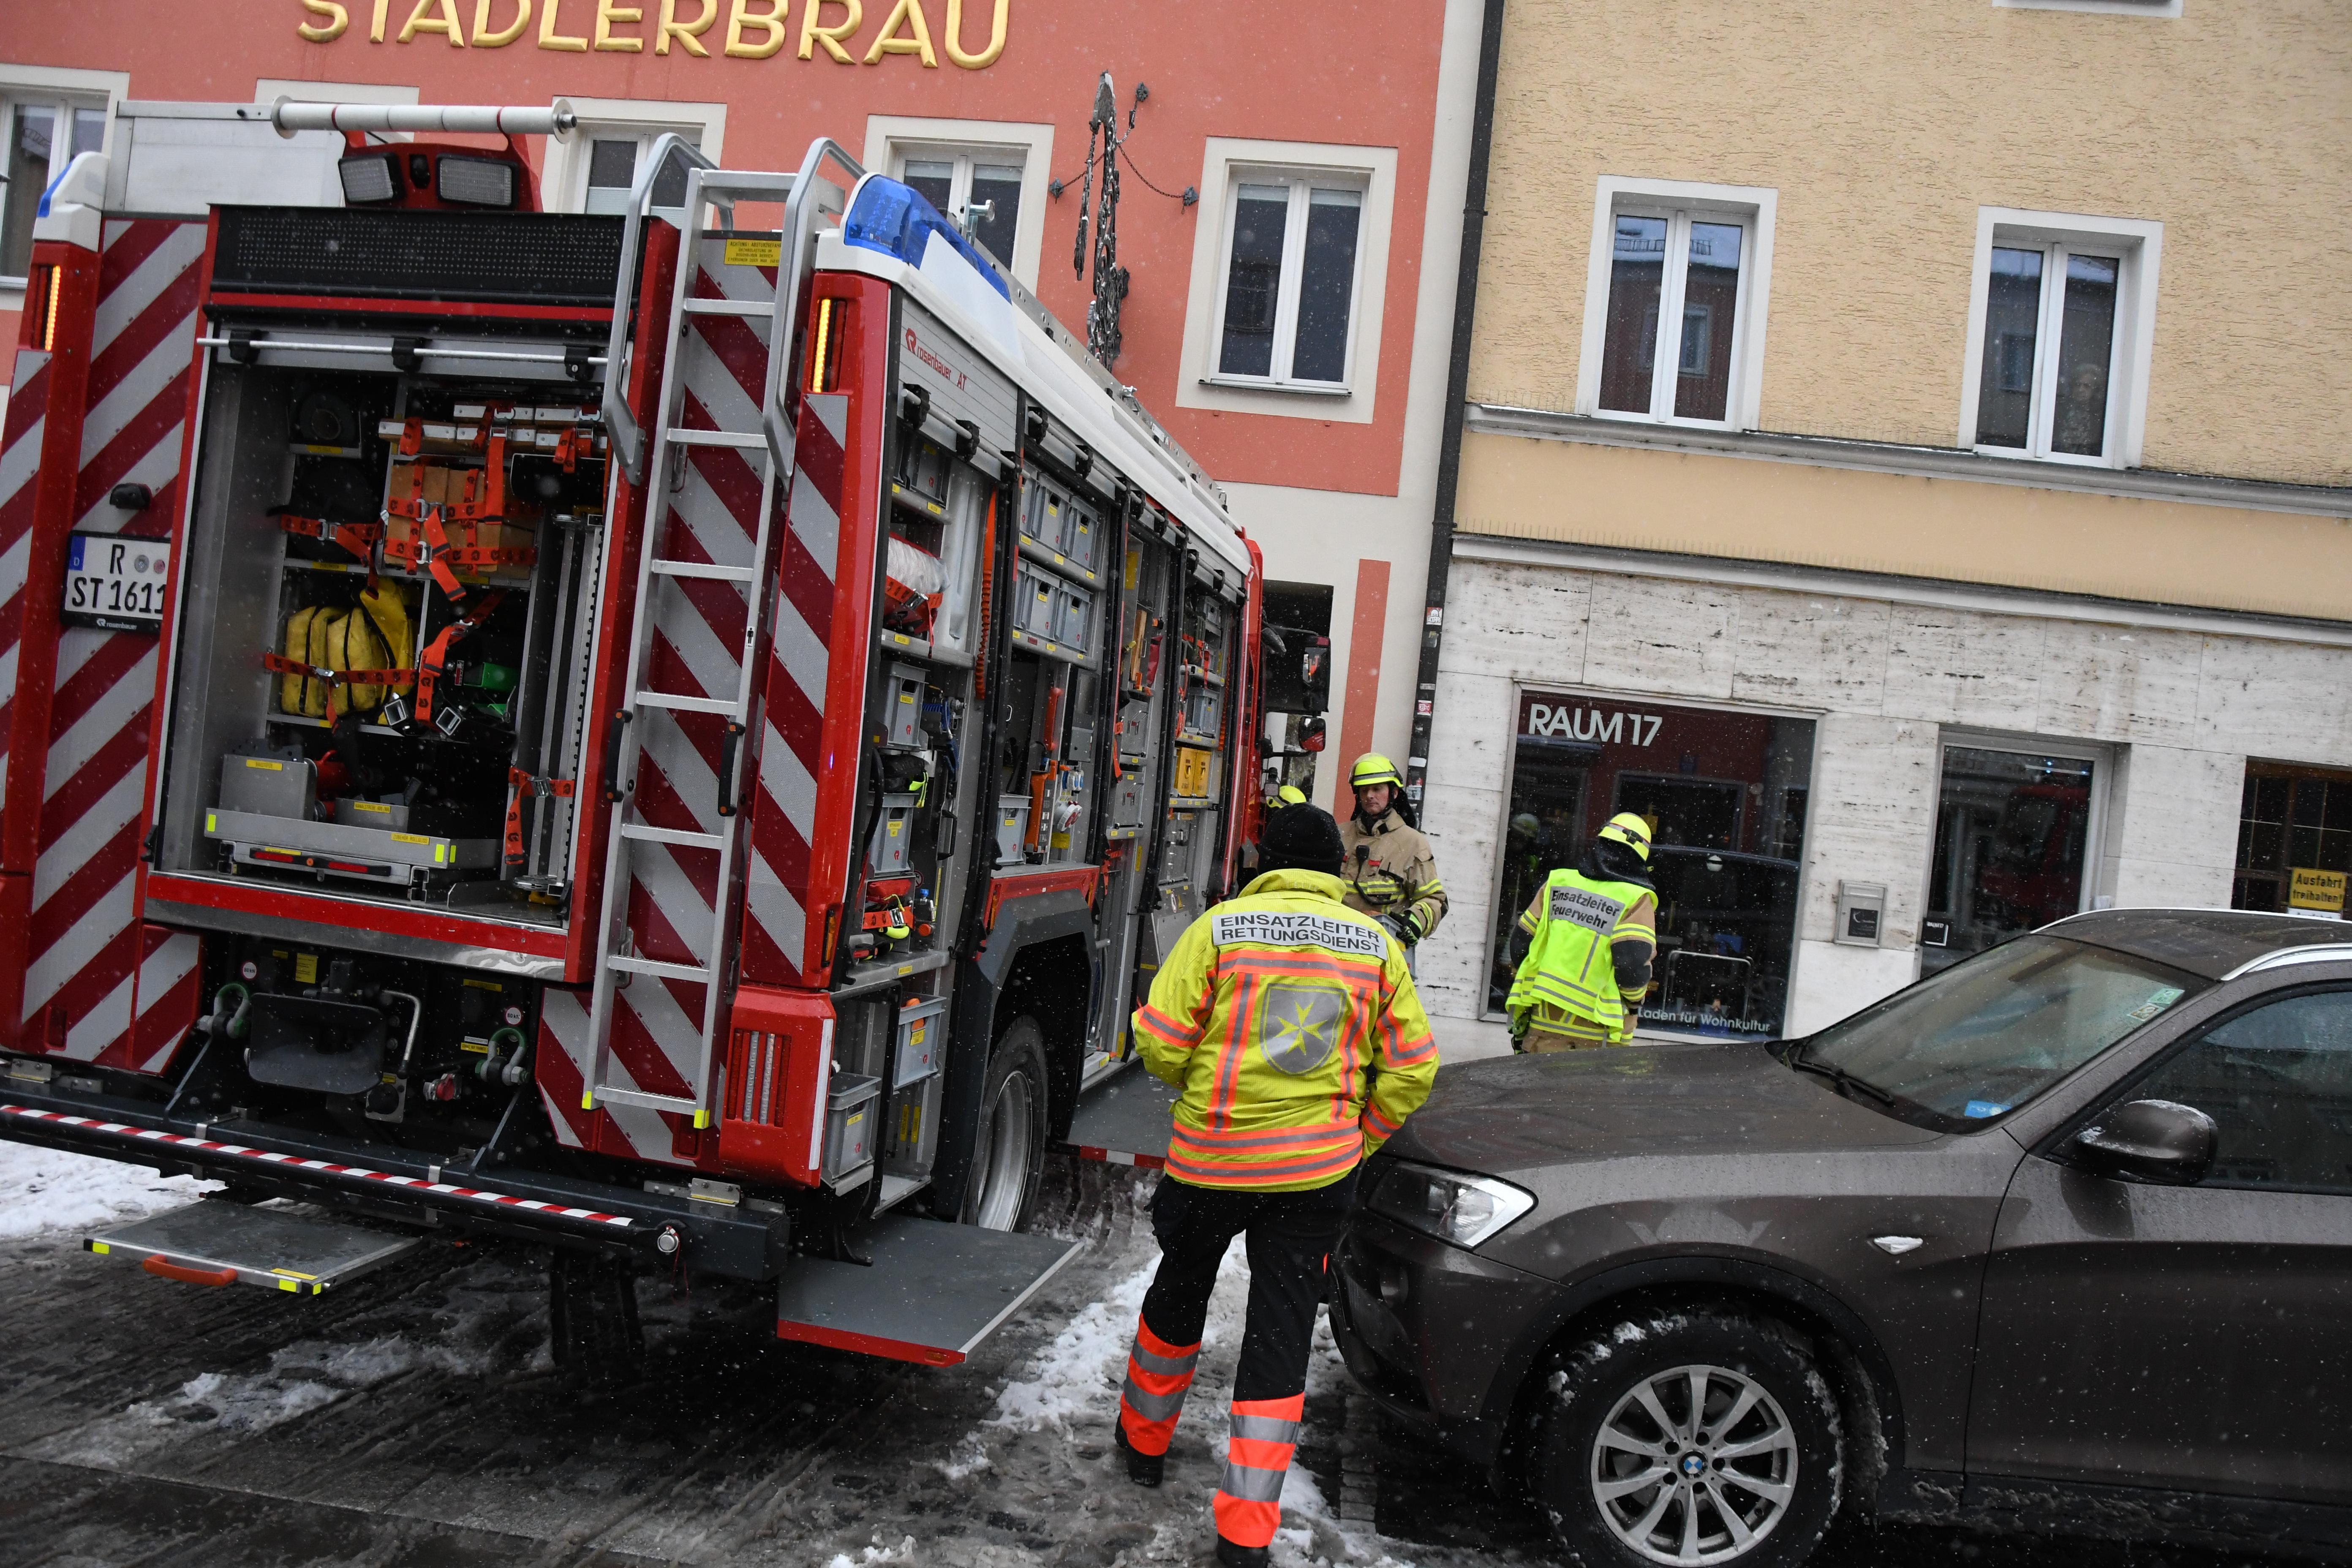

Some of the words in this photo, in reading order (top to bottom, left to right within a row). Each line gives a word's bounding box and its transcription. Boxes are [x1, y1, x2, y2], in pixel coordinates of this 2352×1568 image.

[917, 346, 951, 380] rosenbauer
[956, 372, 966, 391] AT
[73, 557, 80, 566] D
[110, 544, 125, 574] R
[72, 577, 104, 608] ST
[2296, 873, 2342, 889] Ausfahrt
[1551, 890, 1620, 917] Einsatzleiter
[1221, 915, 1379, 942] EINSATZLEITER
[1222, 927, 1380, 953] RETTUNGSDIENST
[1680, 1012, 1697, 1024] für
[1701, 1013, 1770, 1032] Wohnkultur
